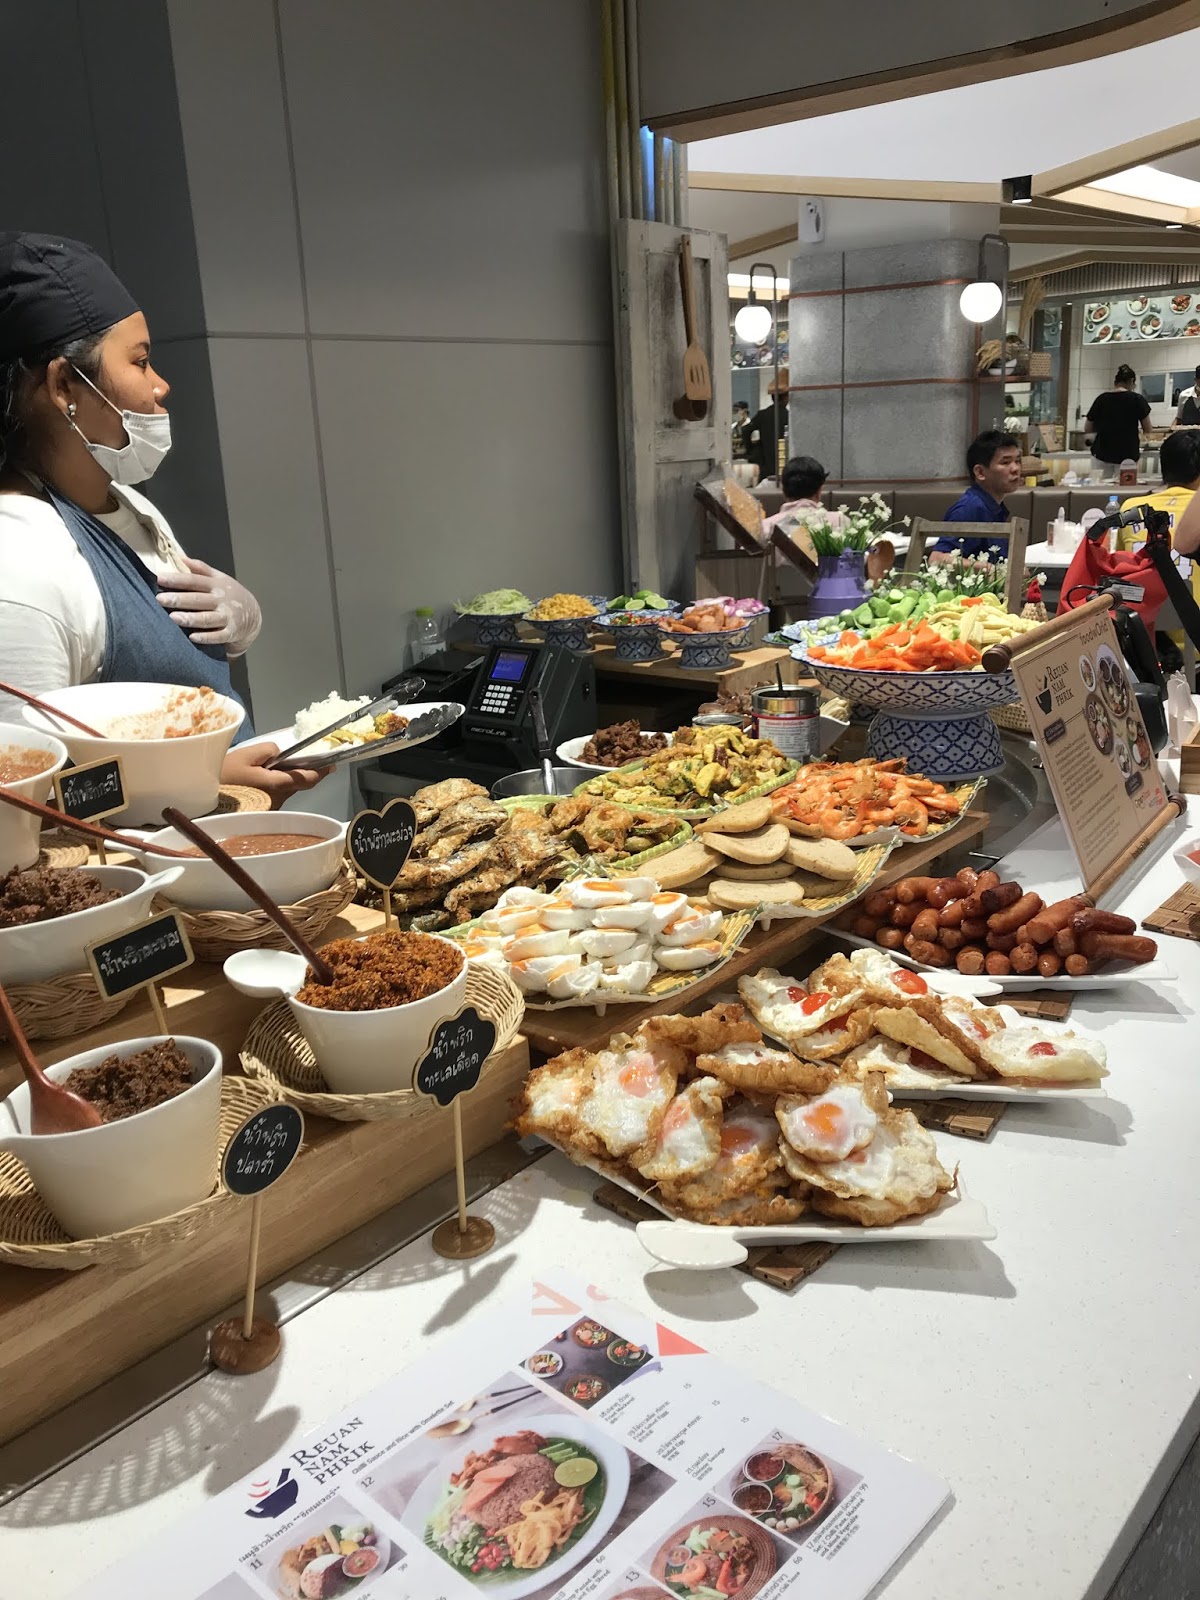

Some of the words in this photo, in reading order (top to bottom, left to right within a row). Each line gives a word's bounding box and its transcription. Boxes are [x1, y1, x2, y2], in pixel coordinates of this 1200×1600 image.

[243, 1117, 288, 1148] น้ำพริก
[236, 1149, 276, 1176] ปลาร้า
[290, 1416, 364, 1468] REUAN
[772, 1431, 783, 1441] 17
[303, 1442, 350, 1476] NAM
[314, 1441, 375, 1486] PHRIK
[360, 1476, 375, 1489] 12
[702, 1496, 716, 1508] 15
[249, 1558, 264, 1571] 11
[625, 1570, 641, 1583] 13
